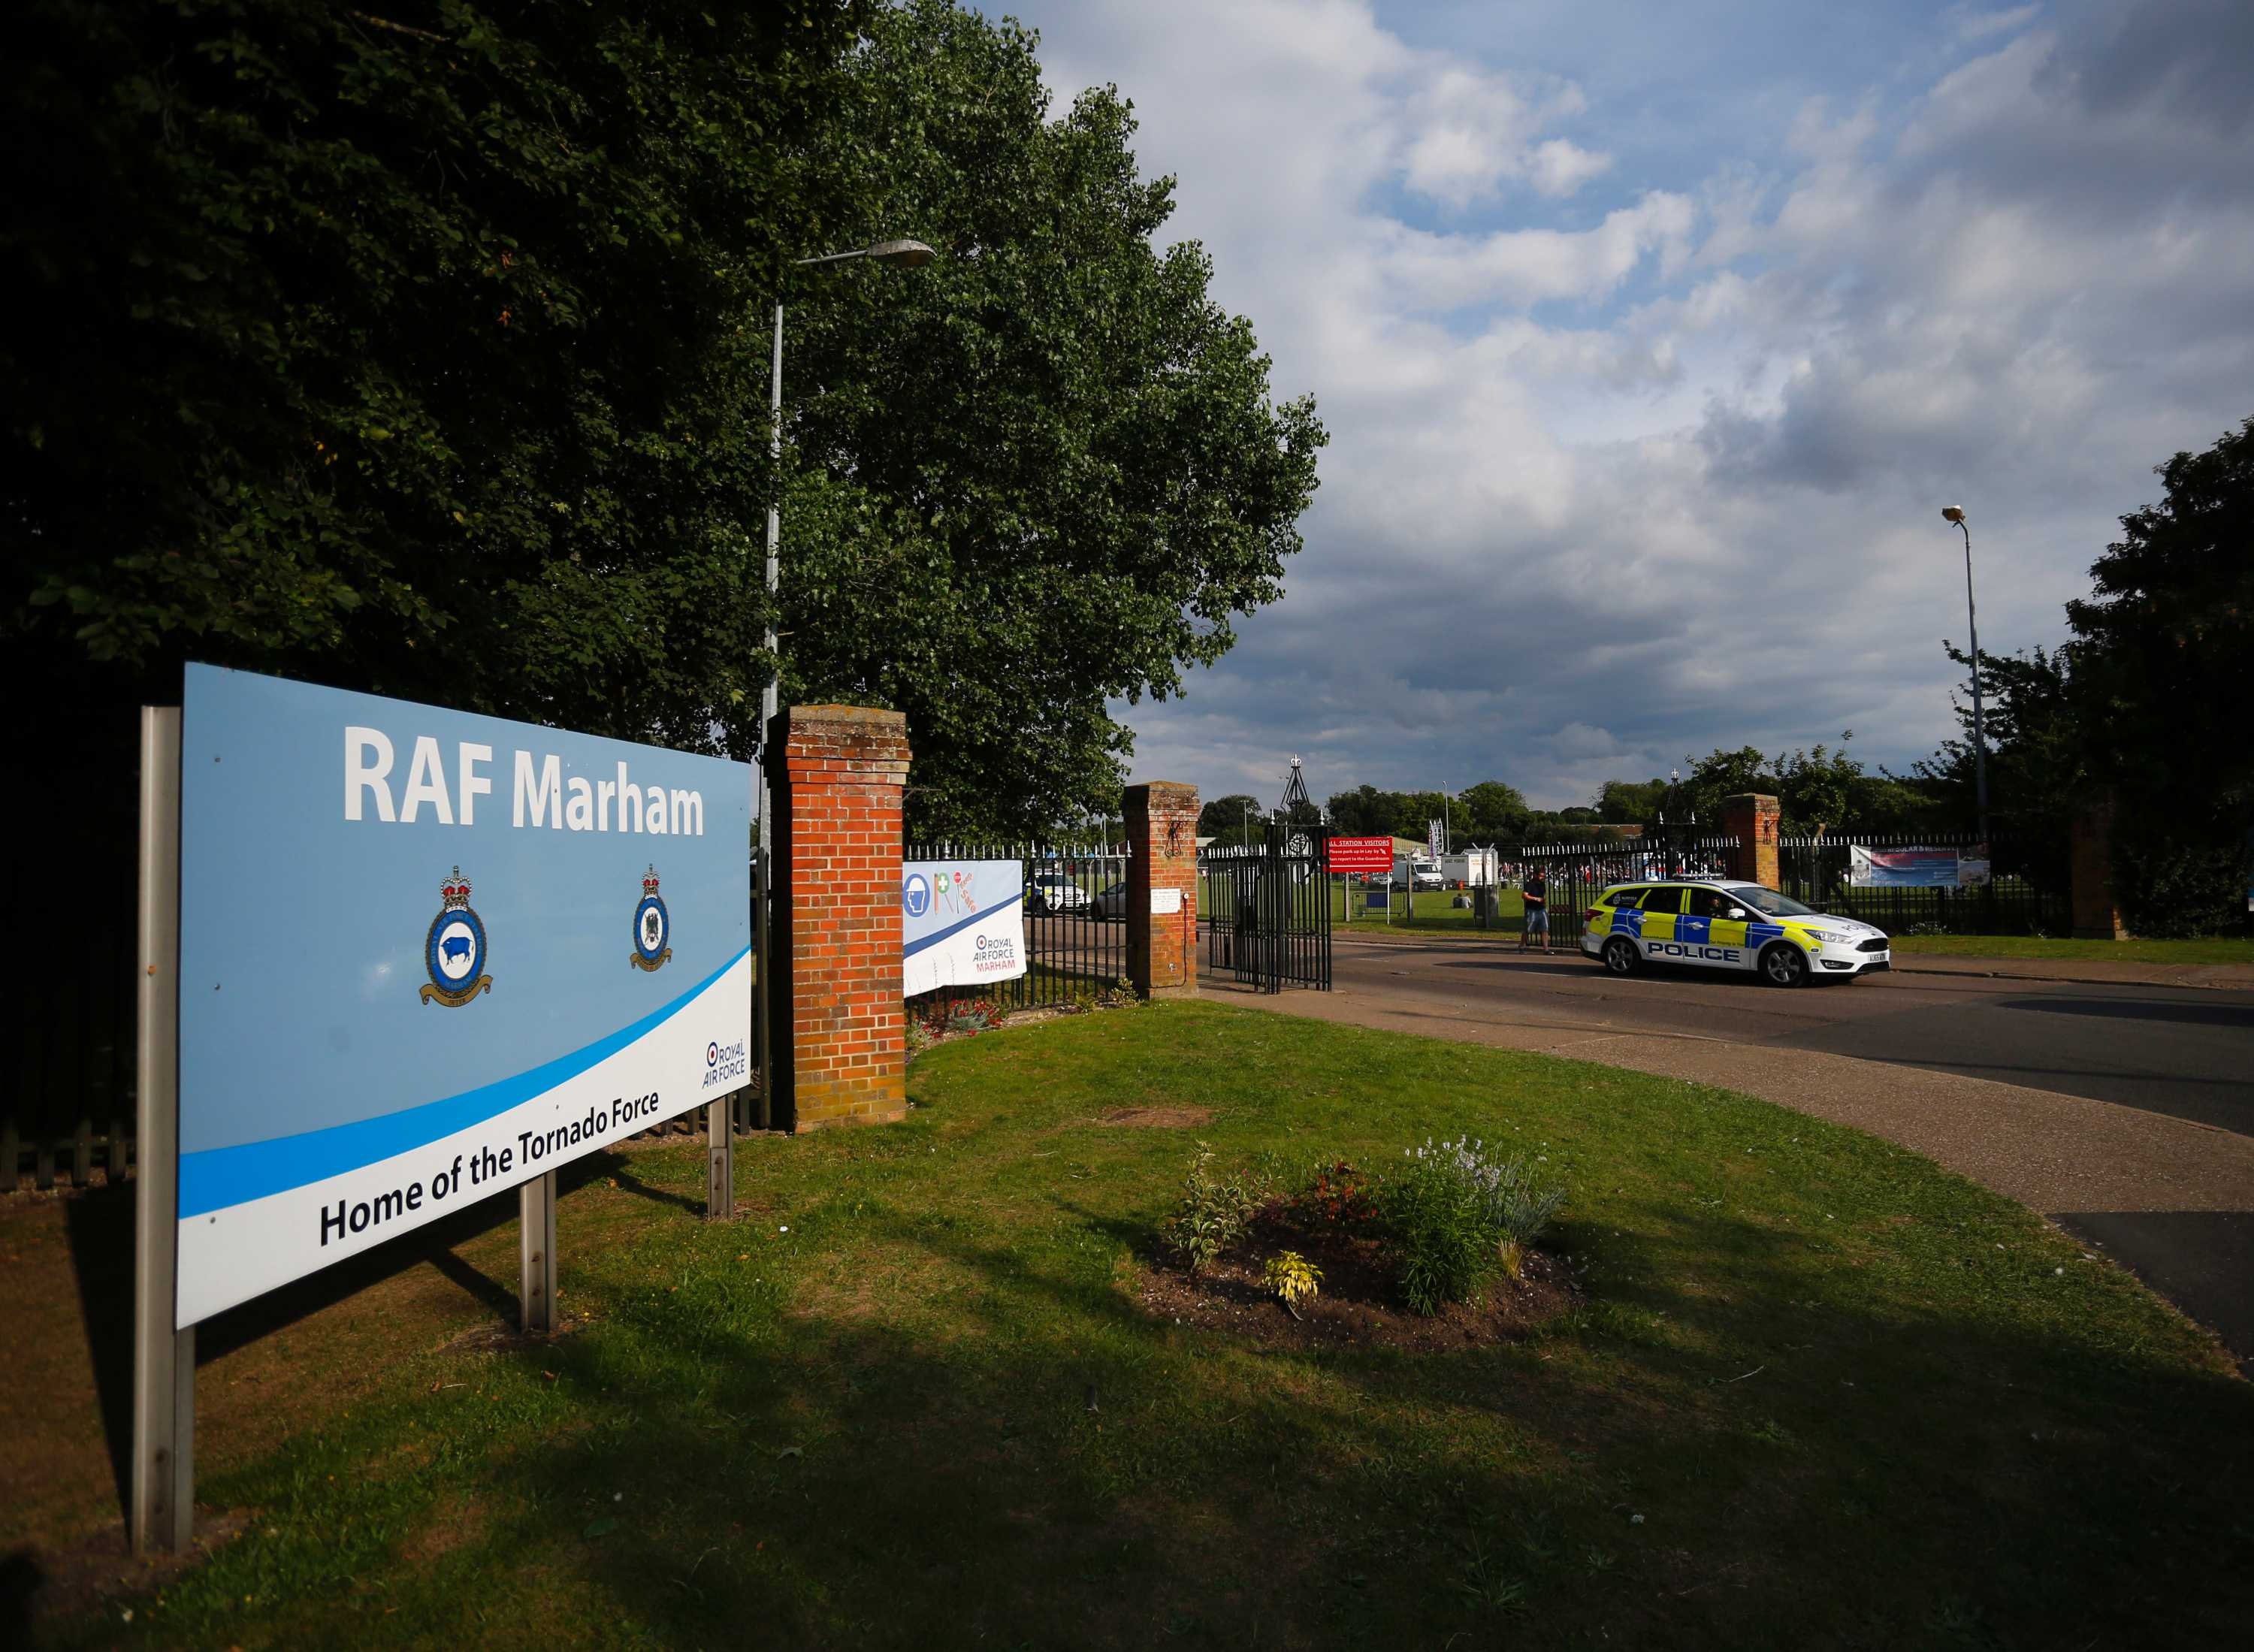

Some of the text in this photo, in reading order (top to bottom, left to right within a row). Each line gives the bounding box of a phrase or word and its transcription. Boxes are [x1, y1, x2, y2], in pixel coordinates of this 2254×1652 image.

[345, 726, 703, 836] RAF Marham
[988, 938, 1013, 949] ROYAL
[1648, 942, 1740, 962] POLICE
[973, 949, 1014, 962] AIR FORCE
[977, 959, 1015, 972] MARHAM
[719, 1040, 745, 1064] ROYAL
[702, 1059, 745, 1089] AIR FORCE
[320, 1092, 659, 1247] Home of the Tornado Force
